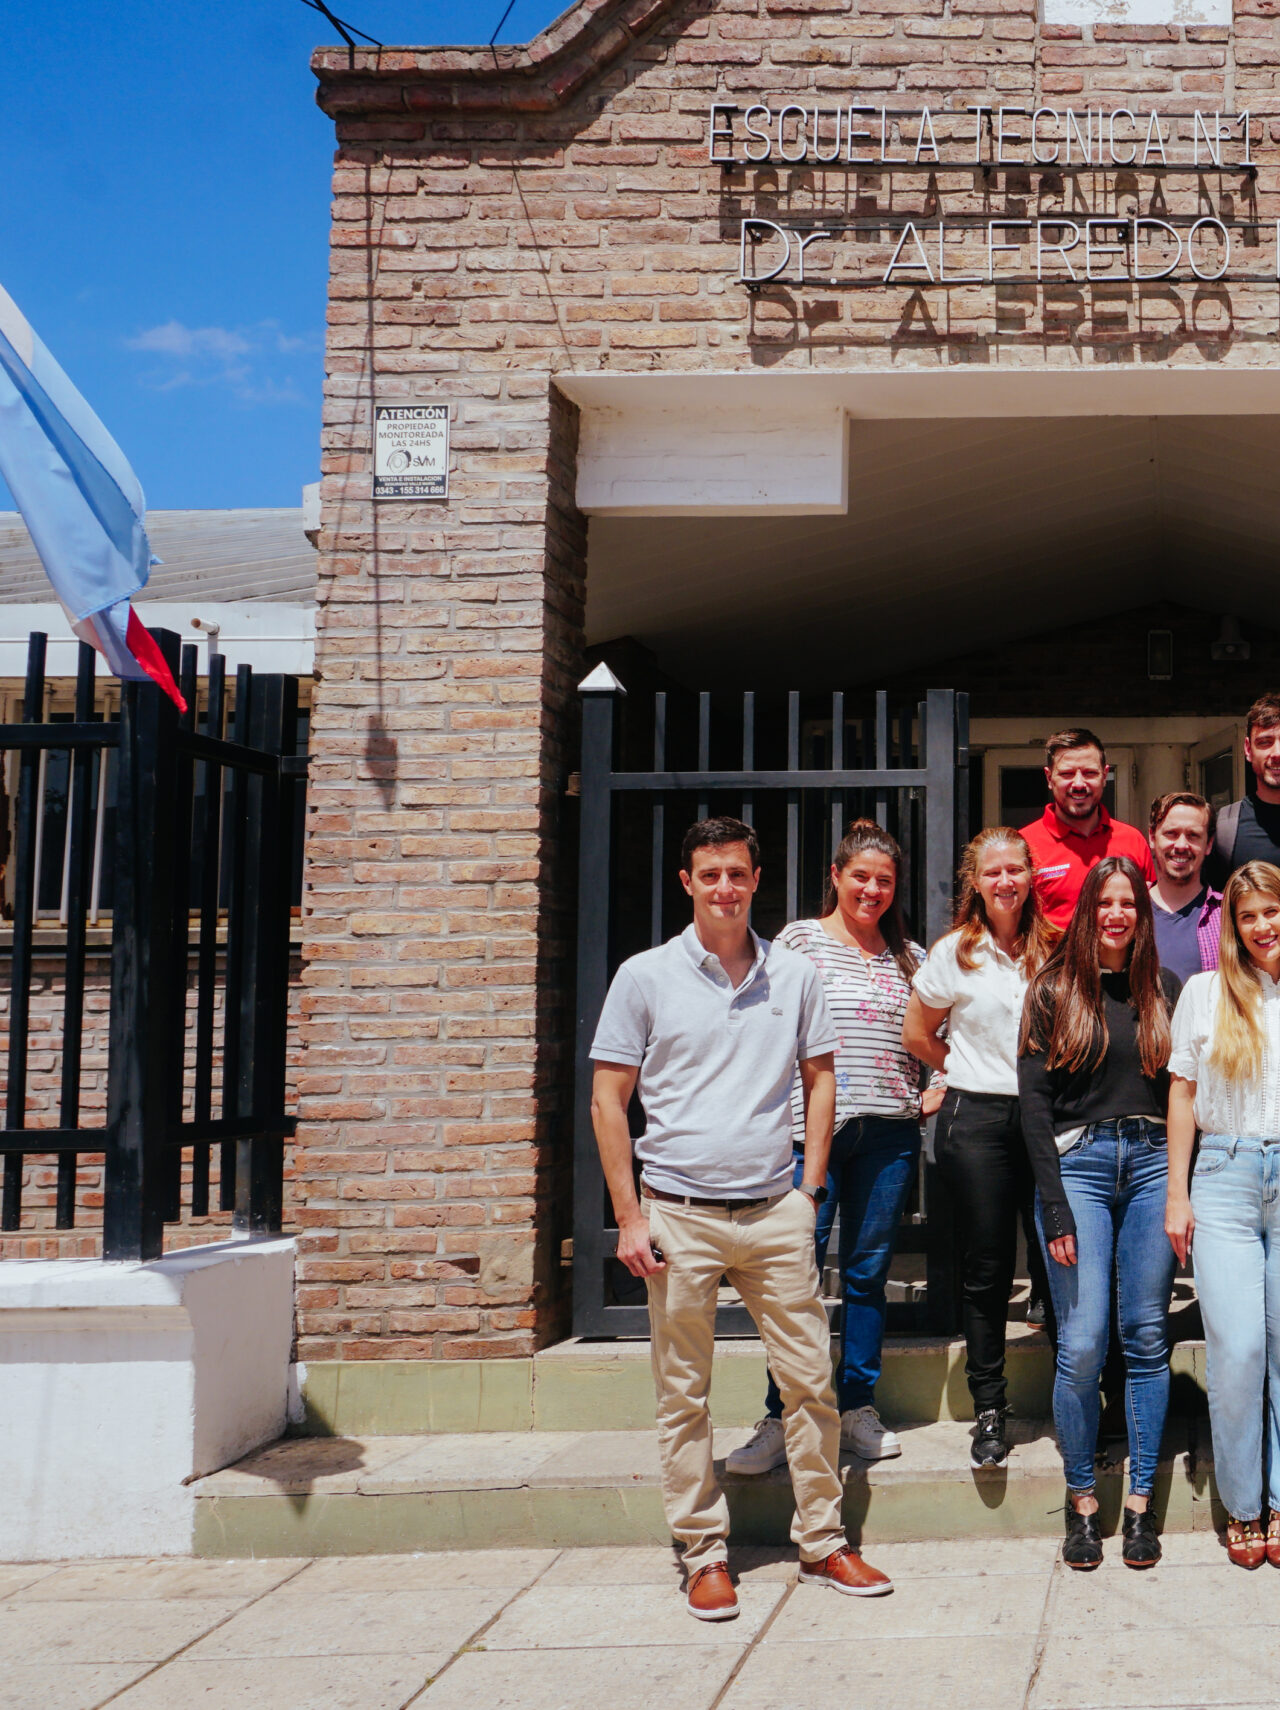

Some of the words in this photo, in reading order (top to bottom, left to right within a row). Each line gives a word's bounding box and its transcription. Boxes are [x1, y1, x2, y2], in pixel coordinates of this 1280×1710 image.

[709, 103, 940, 165] ESCUELA
[967, 106, 1167, 166] TECNICA
[883, 217, 1231, 283] ALFREDO
[379, 406, 446, 420] ATENCIÓN
[387, 422, 437, 431] PROPIEDAD
[378, 431, 444, 439] MONITOREADA
[375, 486, 394, 495] 0343
[400, 486, 414, 495] 155
